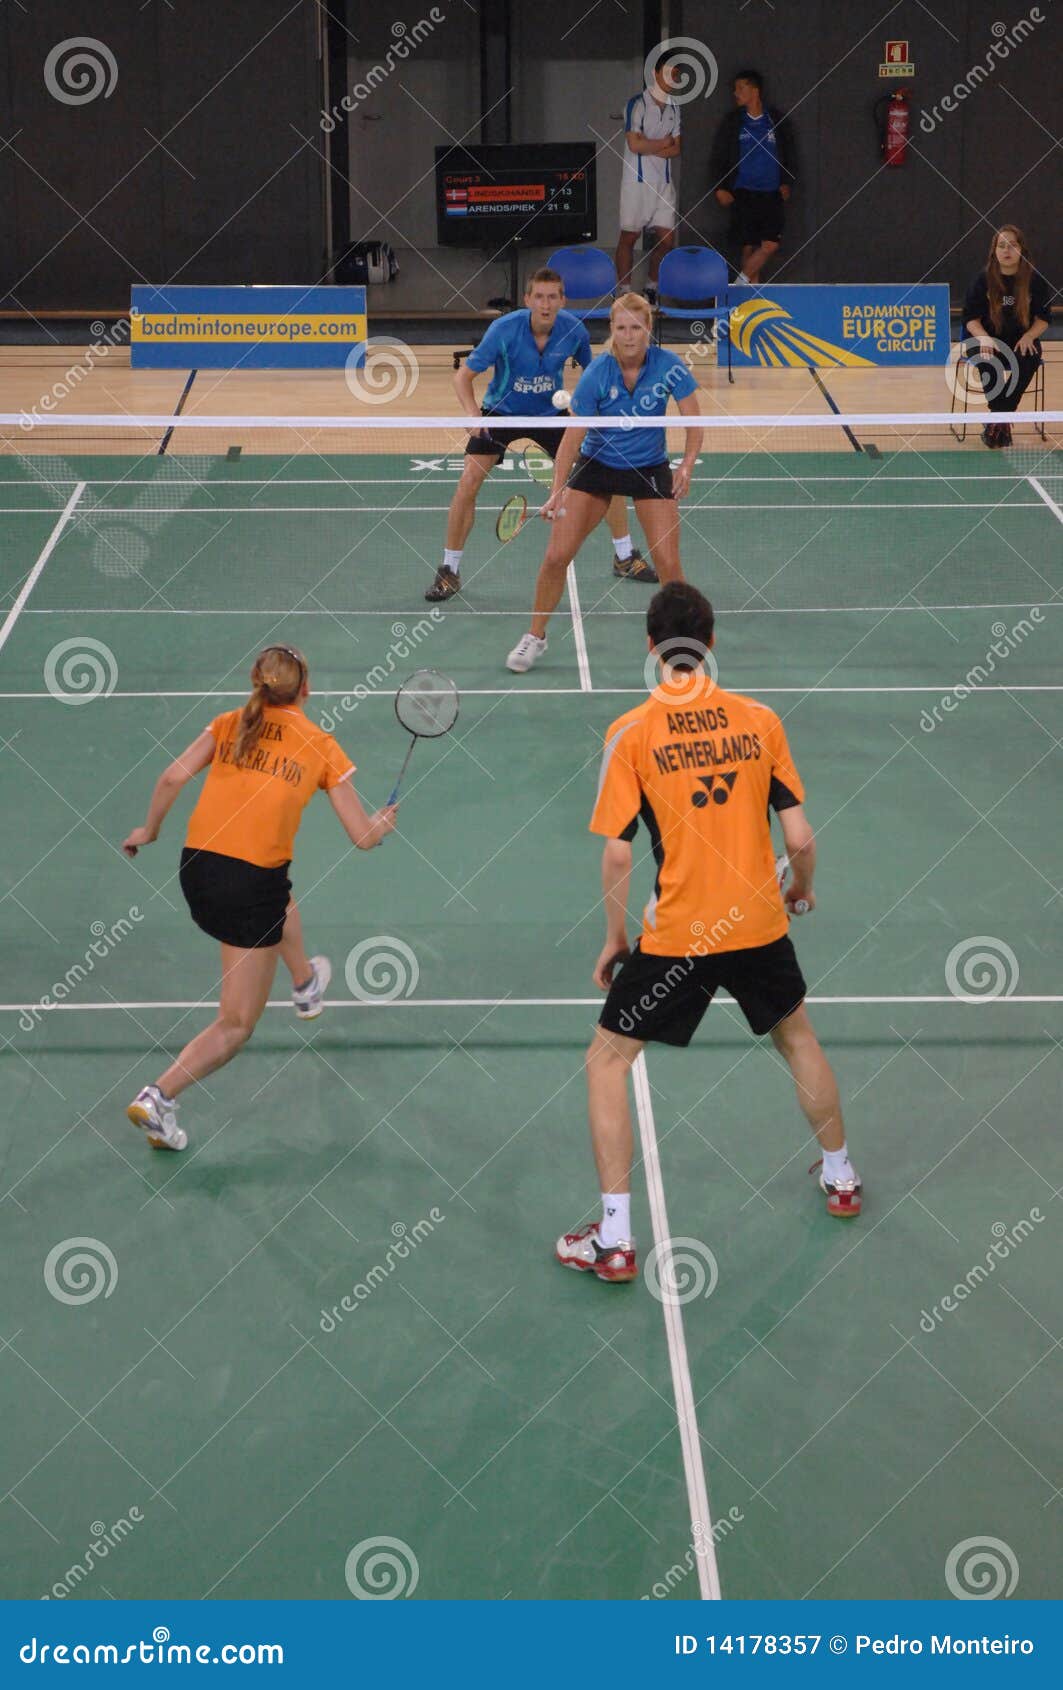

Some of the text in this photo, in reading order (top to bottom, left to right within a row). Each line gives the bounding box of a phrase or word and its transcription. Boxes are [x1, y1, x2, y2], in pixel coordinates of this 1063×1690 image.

[550, 188, 556, 196] 7
[562, 187, 572, 195] 13
[468, 203, 536, 213] ARENDS/PIEK
[547, 203, 558, 211] 21
[842, 304, 936, 318] BADMINTON
[141, 316, 358, 341] badmintoneurope.com
[842, 319, 937, 338] EUROPE
[876, 338, 936, 352] CIRCUIT
[666, 706, 729, 735] ARENDS
[257, 720, 286, 742] IEK
[218, 741, 306, 787] NEERLANDS
[652, 733, 762, 775] NETHERLANDS
